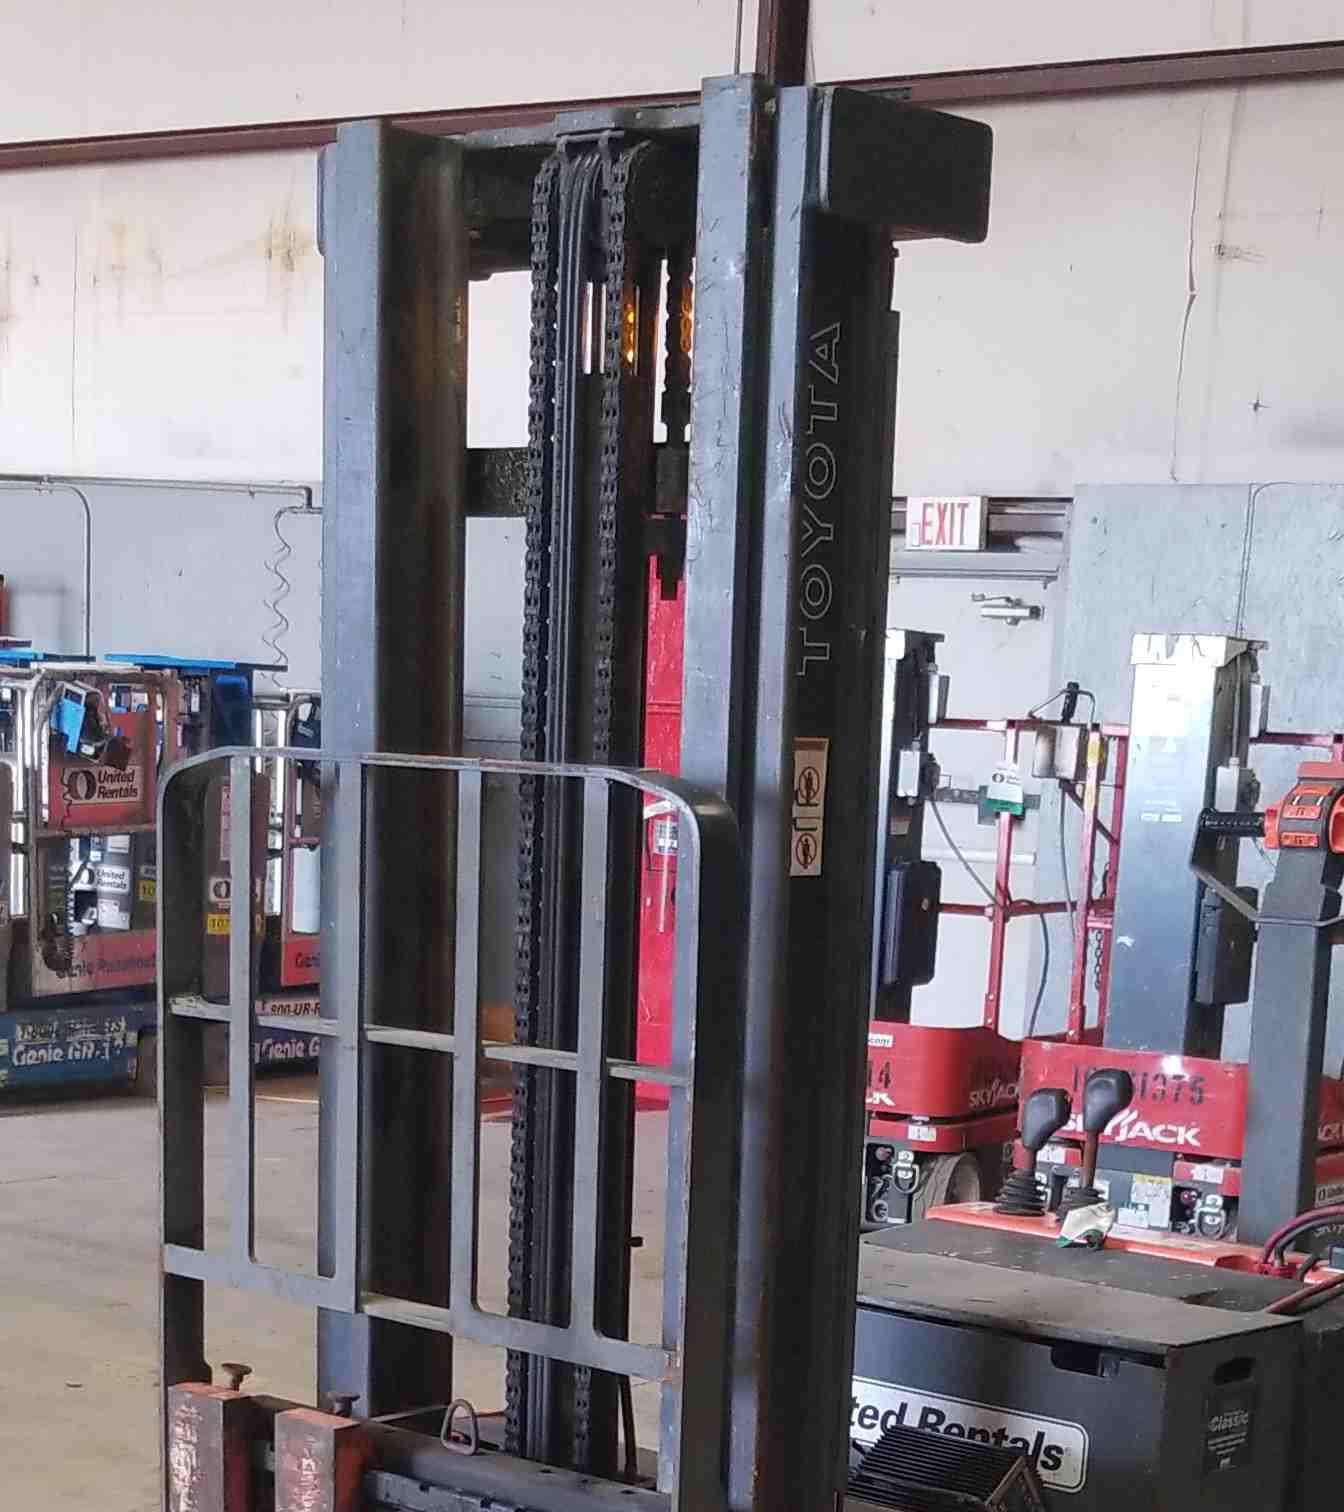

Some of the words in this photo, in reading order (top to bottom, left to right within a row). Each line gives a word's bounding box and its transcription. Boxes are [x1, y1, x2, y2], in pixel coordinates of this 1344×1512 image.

[797, 321, 842, 677] TOYOTA
[922, 502, 969, 545] EXIT
[97, 768, 136, 785] United
[97, 783, 139, 800] Rentals
[12, 1043, 64, 1067] Genie
